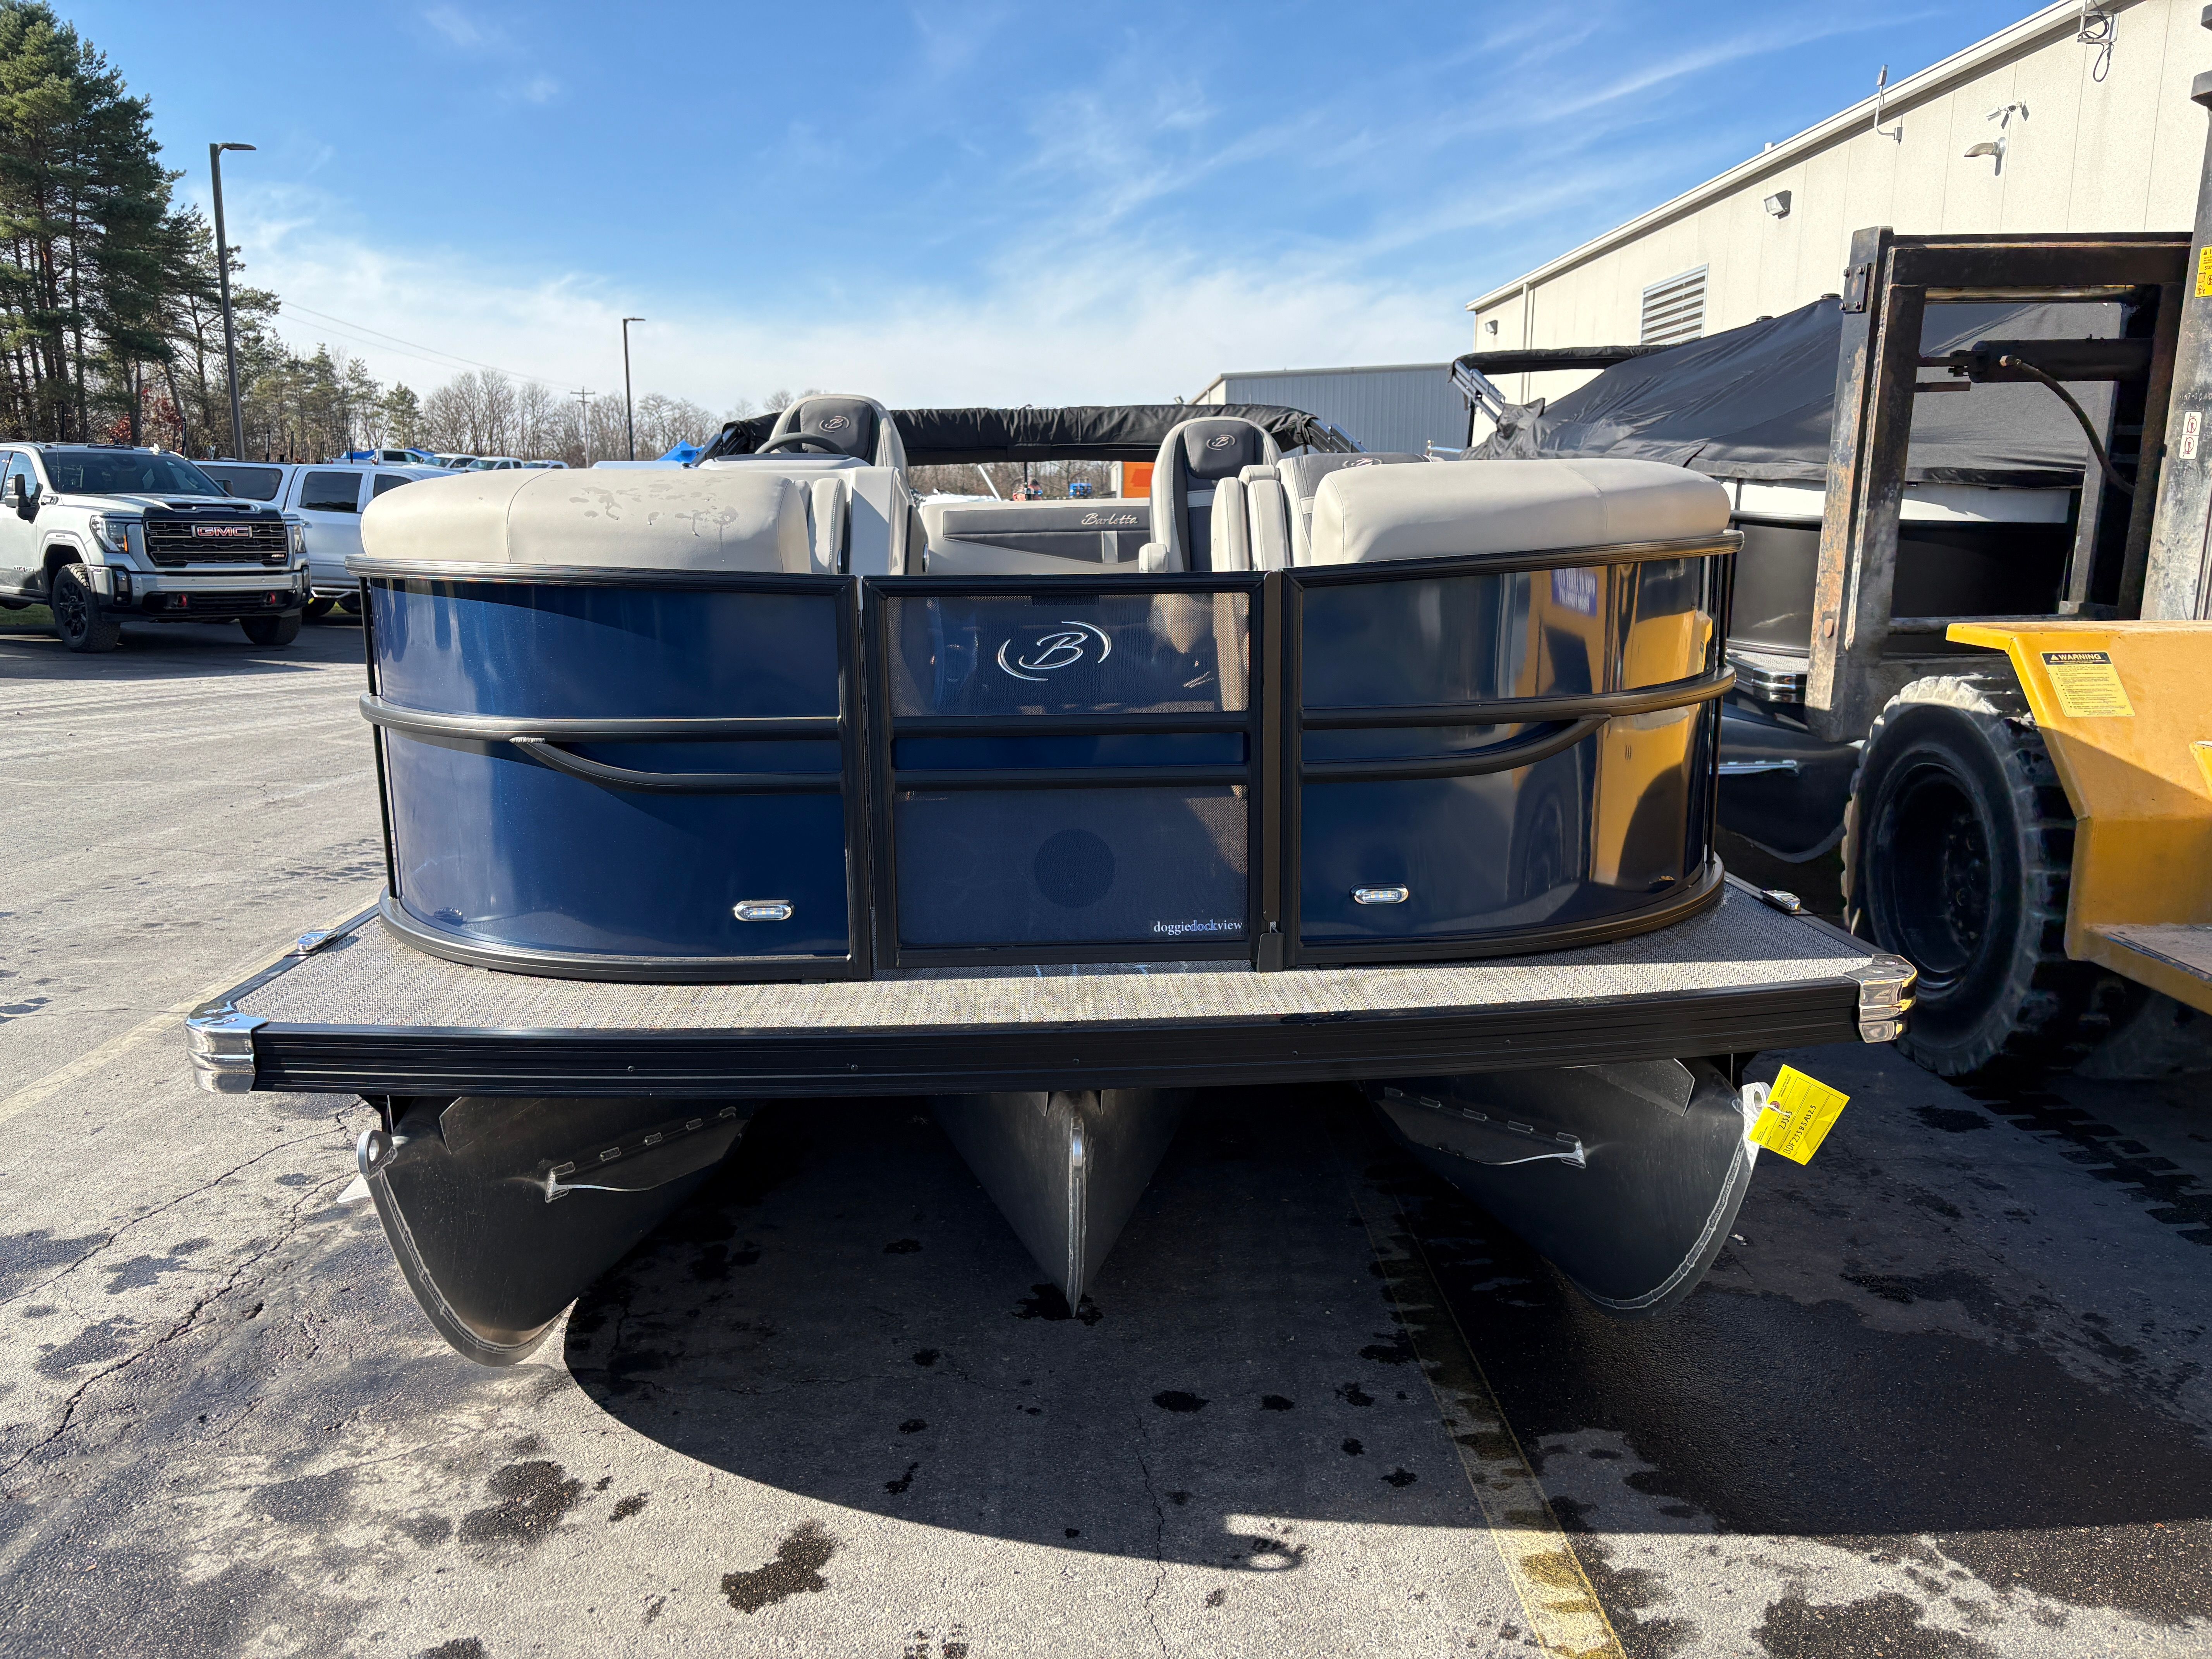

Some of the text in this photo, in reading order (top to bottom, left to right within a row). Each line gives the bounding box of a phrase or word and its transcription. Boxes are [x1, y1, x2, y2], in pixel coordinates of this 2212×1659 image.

[1081, 513, 1139, 525] Barletta
[198, 527, 248, 536] GMC
[1018, 631, 1088, 670] B
[1154, 919, 1242, 935] doggiedockview
